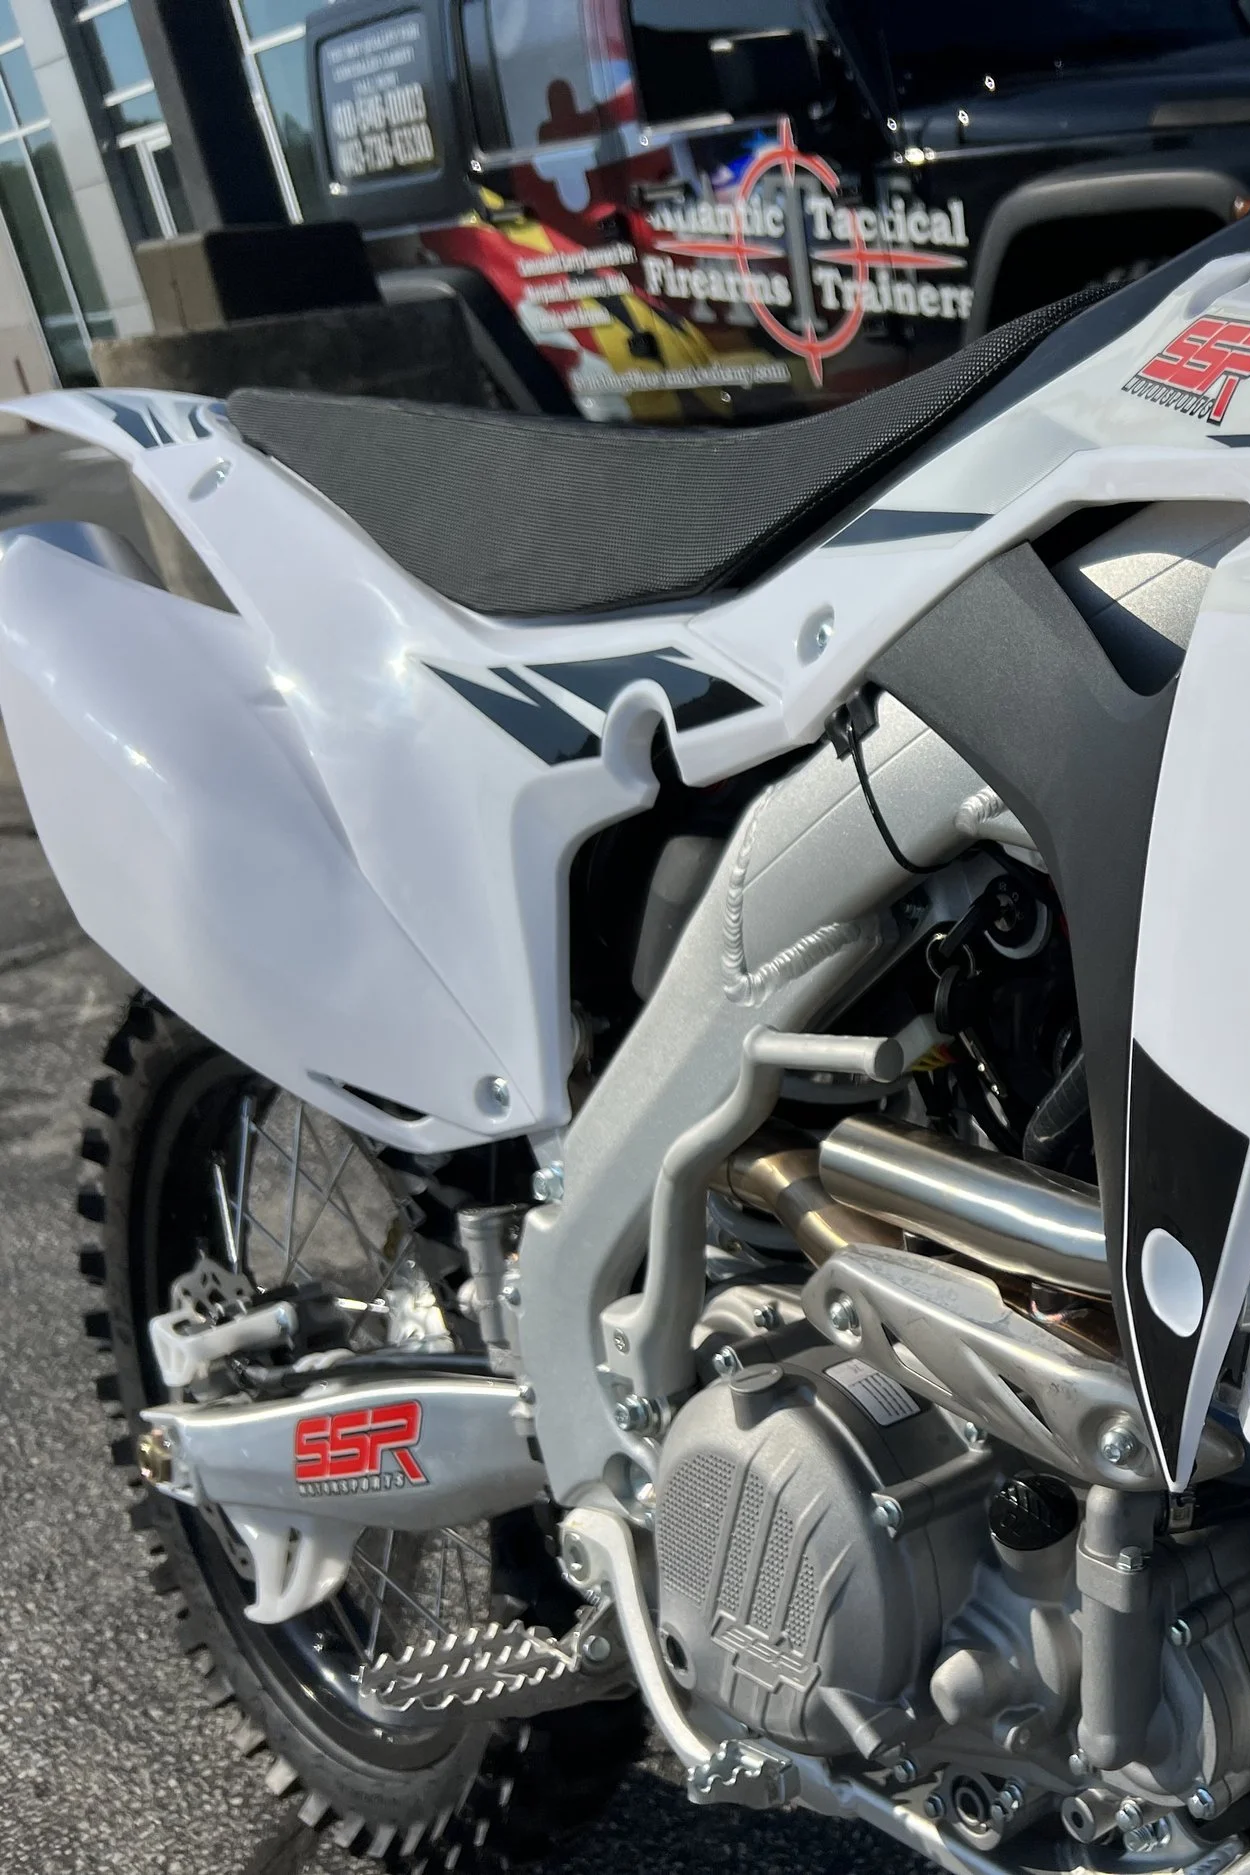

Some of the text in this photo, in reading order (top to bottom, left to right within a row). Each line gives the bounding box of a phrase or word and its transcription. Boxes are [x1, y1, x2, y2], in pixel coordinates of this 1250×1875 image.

[804, 194, 969, 247] Tactical
[643, 253, 792, 306] Firearms
[294, 1399, 429, 1485] SSR
